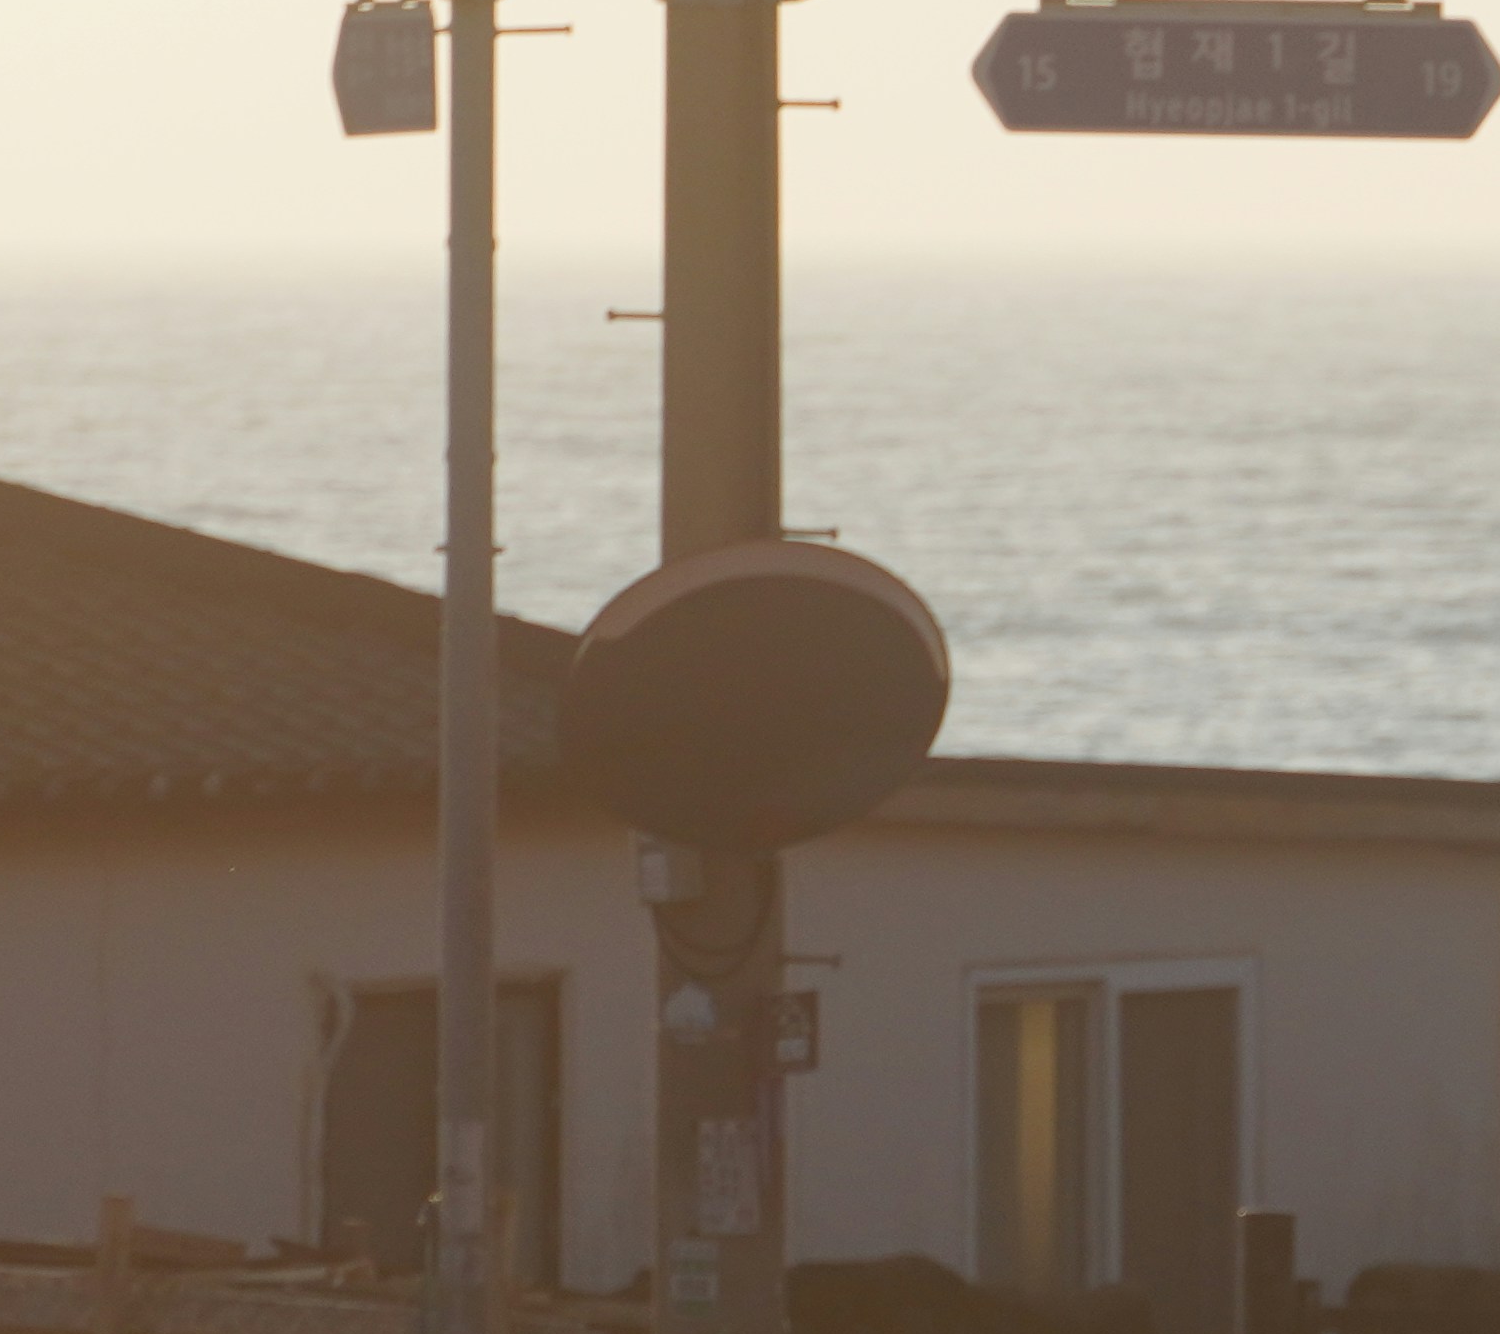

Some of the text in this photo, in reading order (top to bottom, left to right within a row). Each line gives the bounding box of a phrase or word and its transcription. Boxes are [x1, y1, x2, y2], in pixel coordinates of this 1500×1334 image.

[1017, 54, 1057, 91] 15
[1420, 61, 1463, 98] 19
[1125, 91, 1355, 128] Hyeopjae 1-gil
